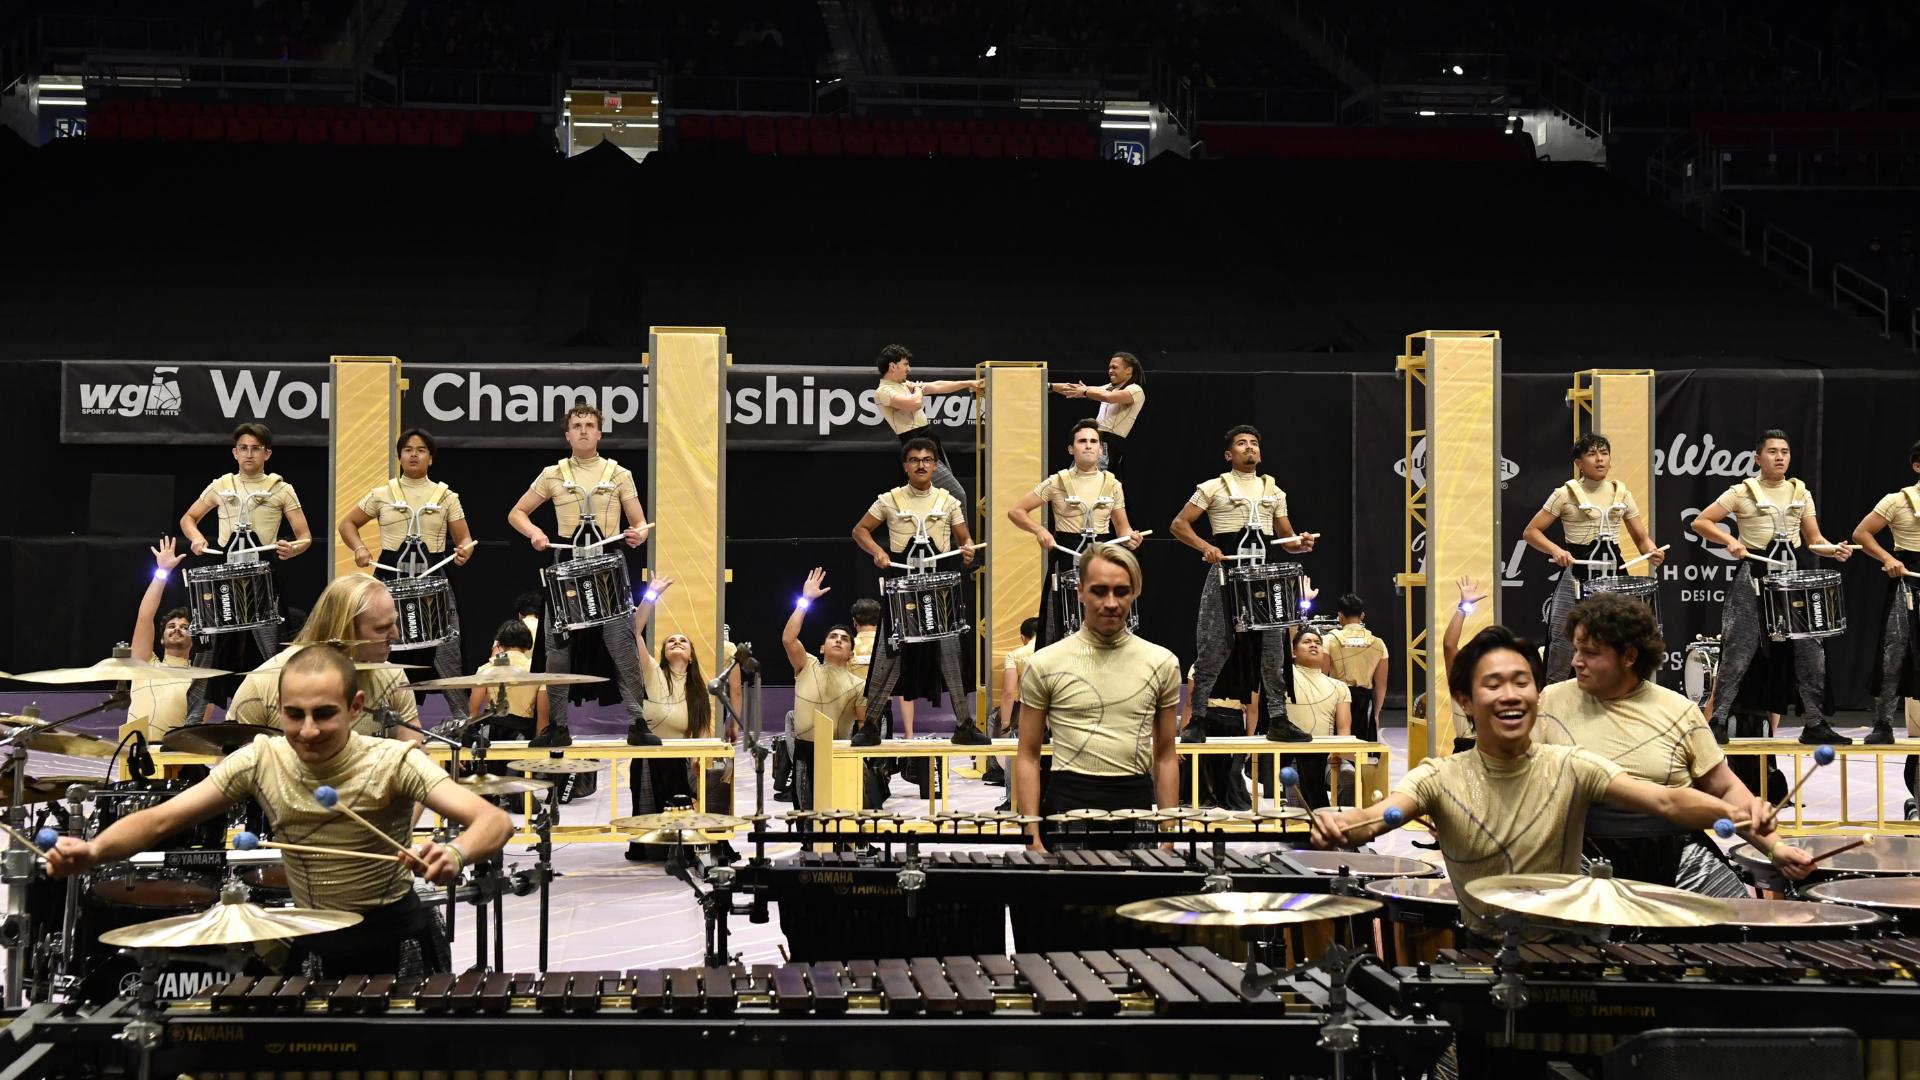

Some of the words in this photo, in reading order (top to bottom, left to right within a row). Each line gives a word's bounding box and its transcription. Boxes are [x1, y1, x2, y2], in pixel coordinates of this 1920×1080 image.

[1655, 564, 1719, 581] HOW
[585, 589, 597, 616] YAMAHA
[1274, 592, 1284, 618] YAMAHA
[1681, 590, 1725, 602] DESIG
[221, 593, 232, 621] YAMAHA
[924, 604, 934, 630] YAMAHA
[1813, 601, 1823, 627] YAMAHA
[407, 611, 418, 639] YAMAHA
[181, 854, 221, 865] YAMAHA
[812, 871, 854, 883] YAMAHA
[1544, 988, 1598, 1002] YAMAHA
[185, 1025, 244, 1041] YAMAHA
